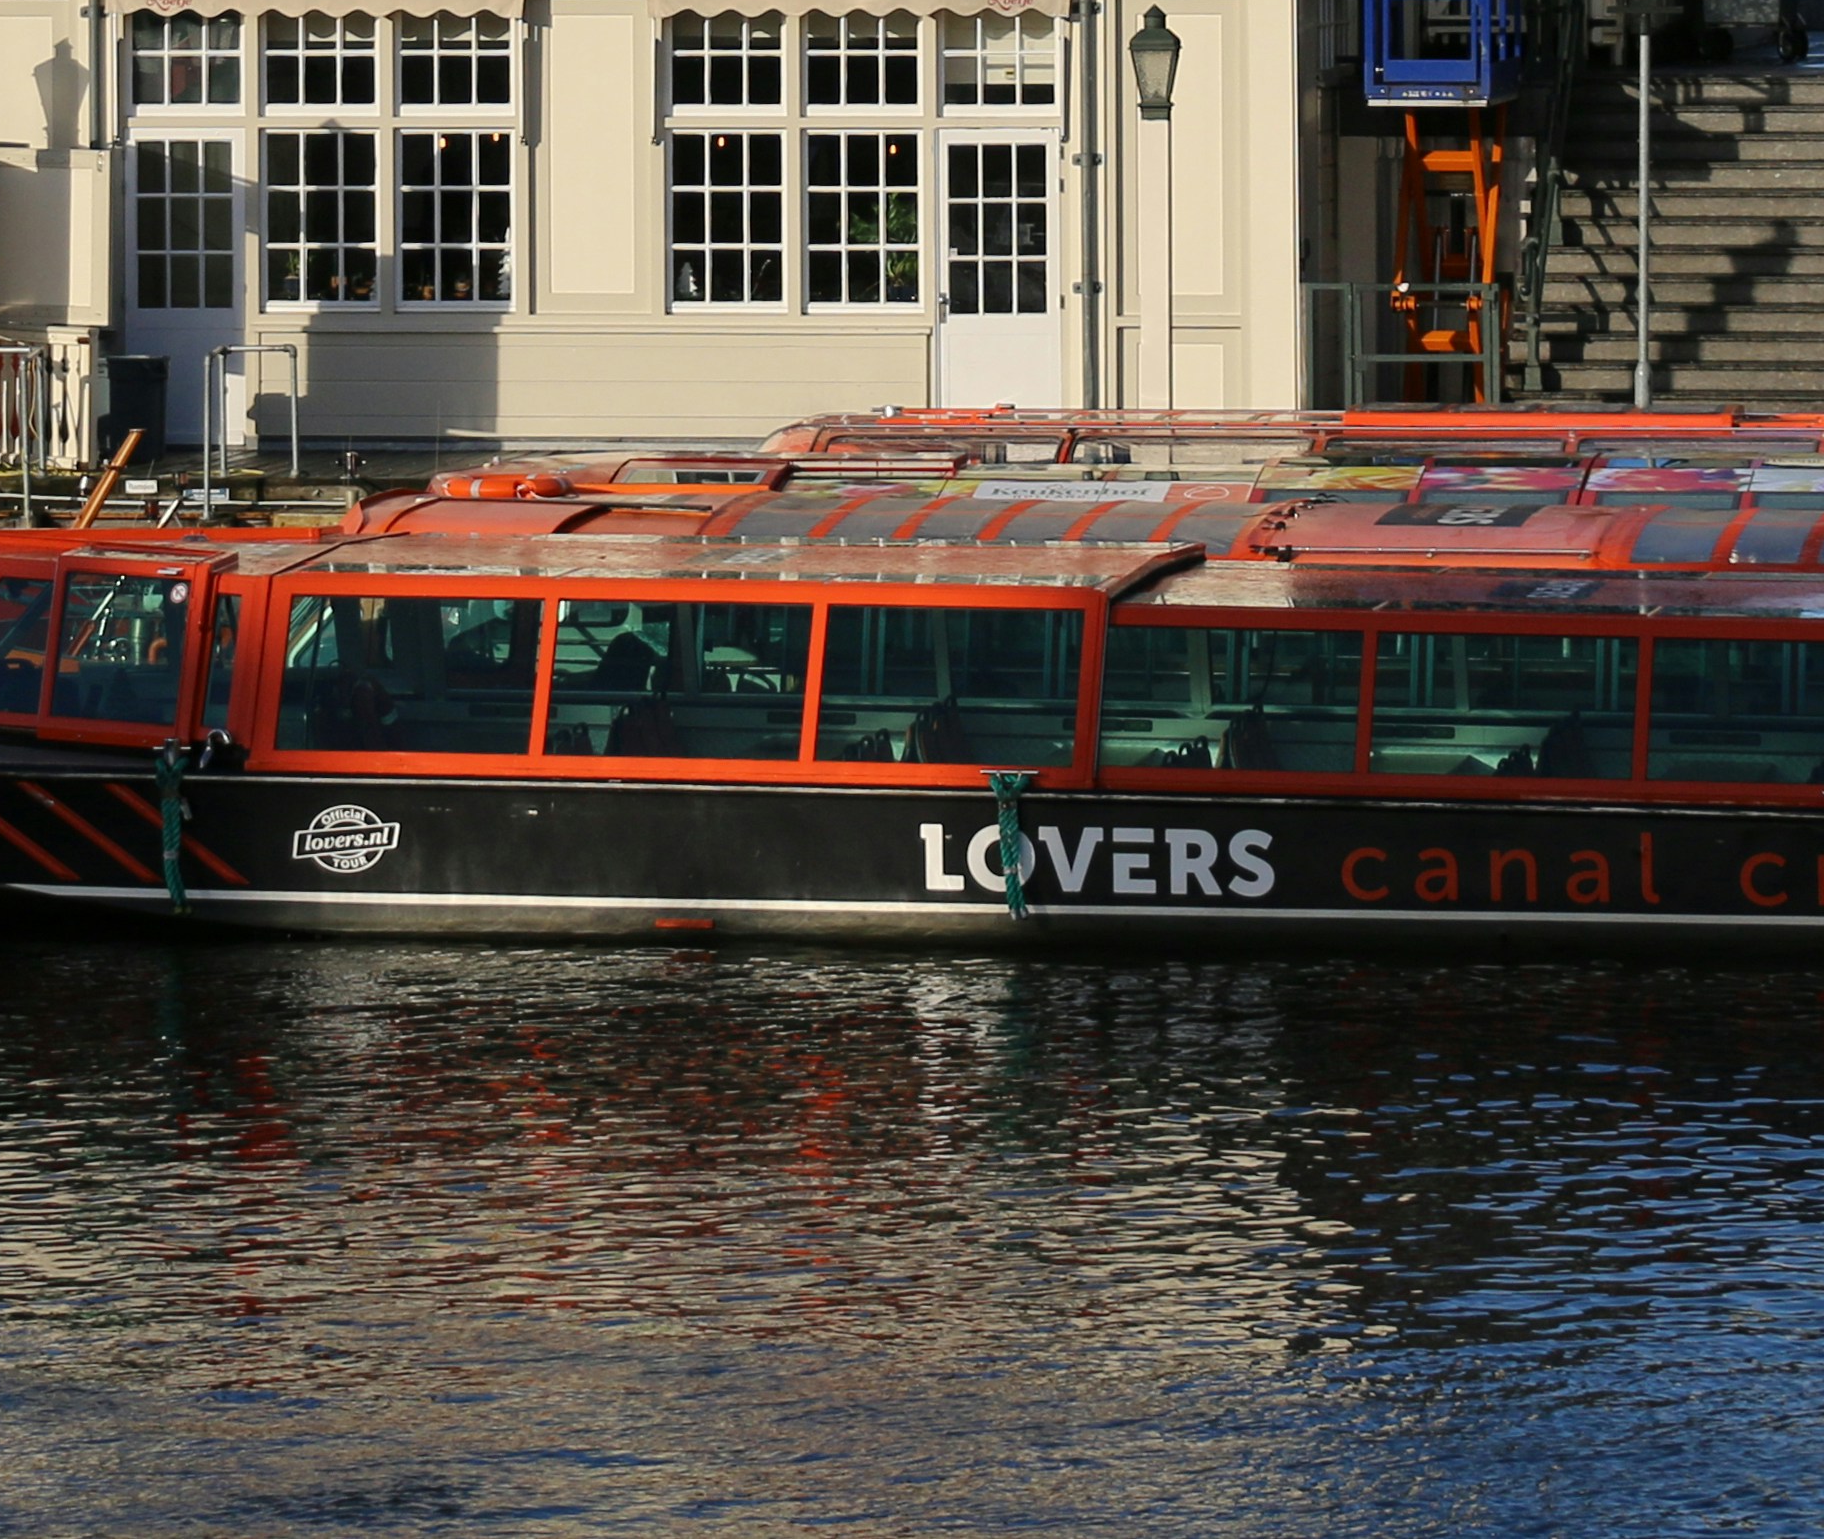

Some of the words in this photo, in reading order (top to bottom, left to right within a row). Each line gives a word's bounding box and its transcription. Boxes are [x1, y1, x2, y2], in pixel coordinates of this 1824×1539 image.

[991, 486, 1150, 496] Keukenhof
[320, 808, 367, 825] Official
[304, 826, 390, 852] lovers.nl
[332, 855, 370, 870] TOUR
[919, 822, 1277, 899] LOVERS
[1341, 831, 1661, 905] canal
